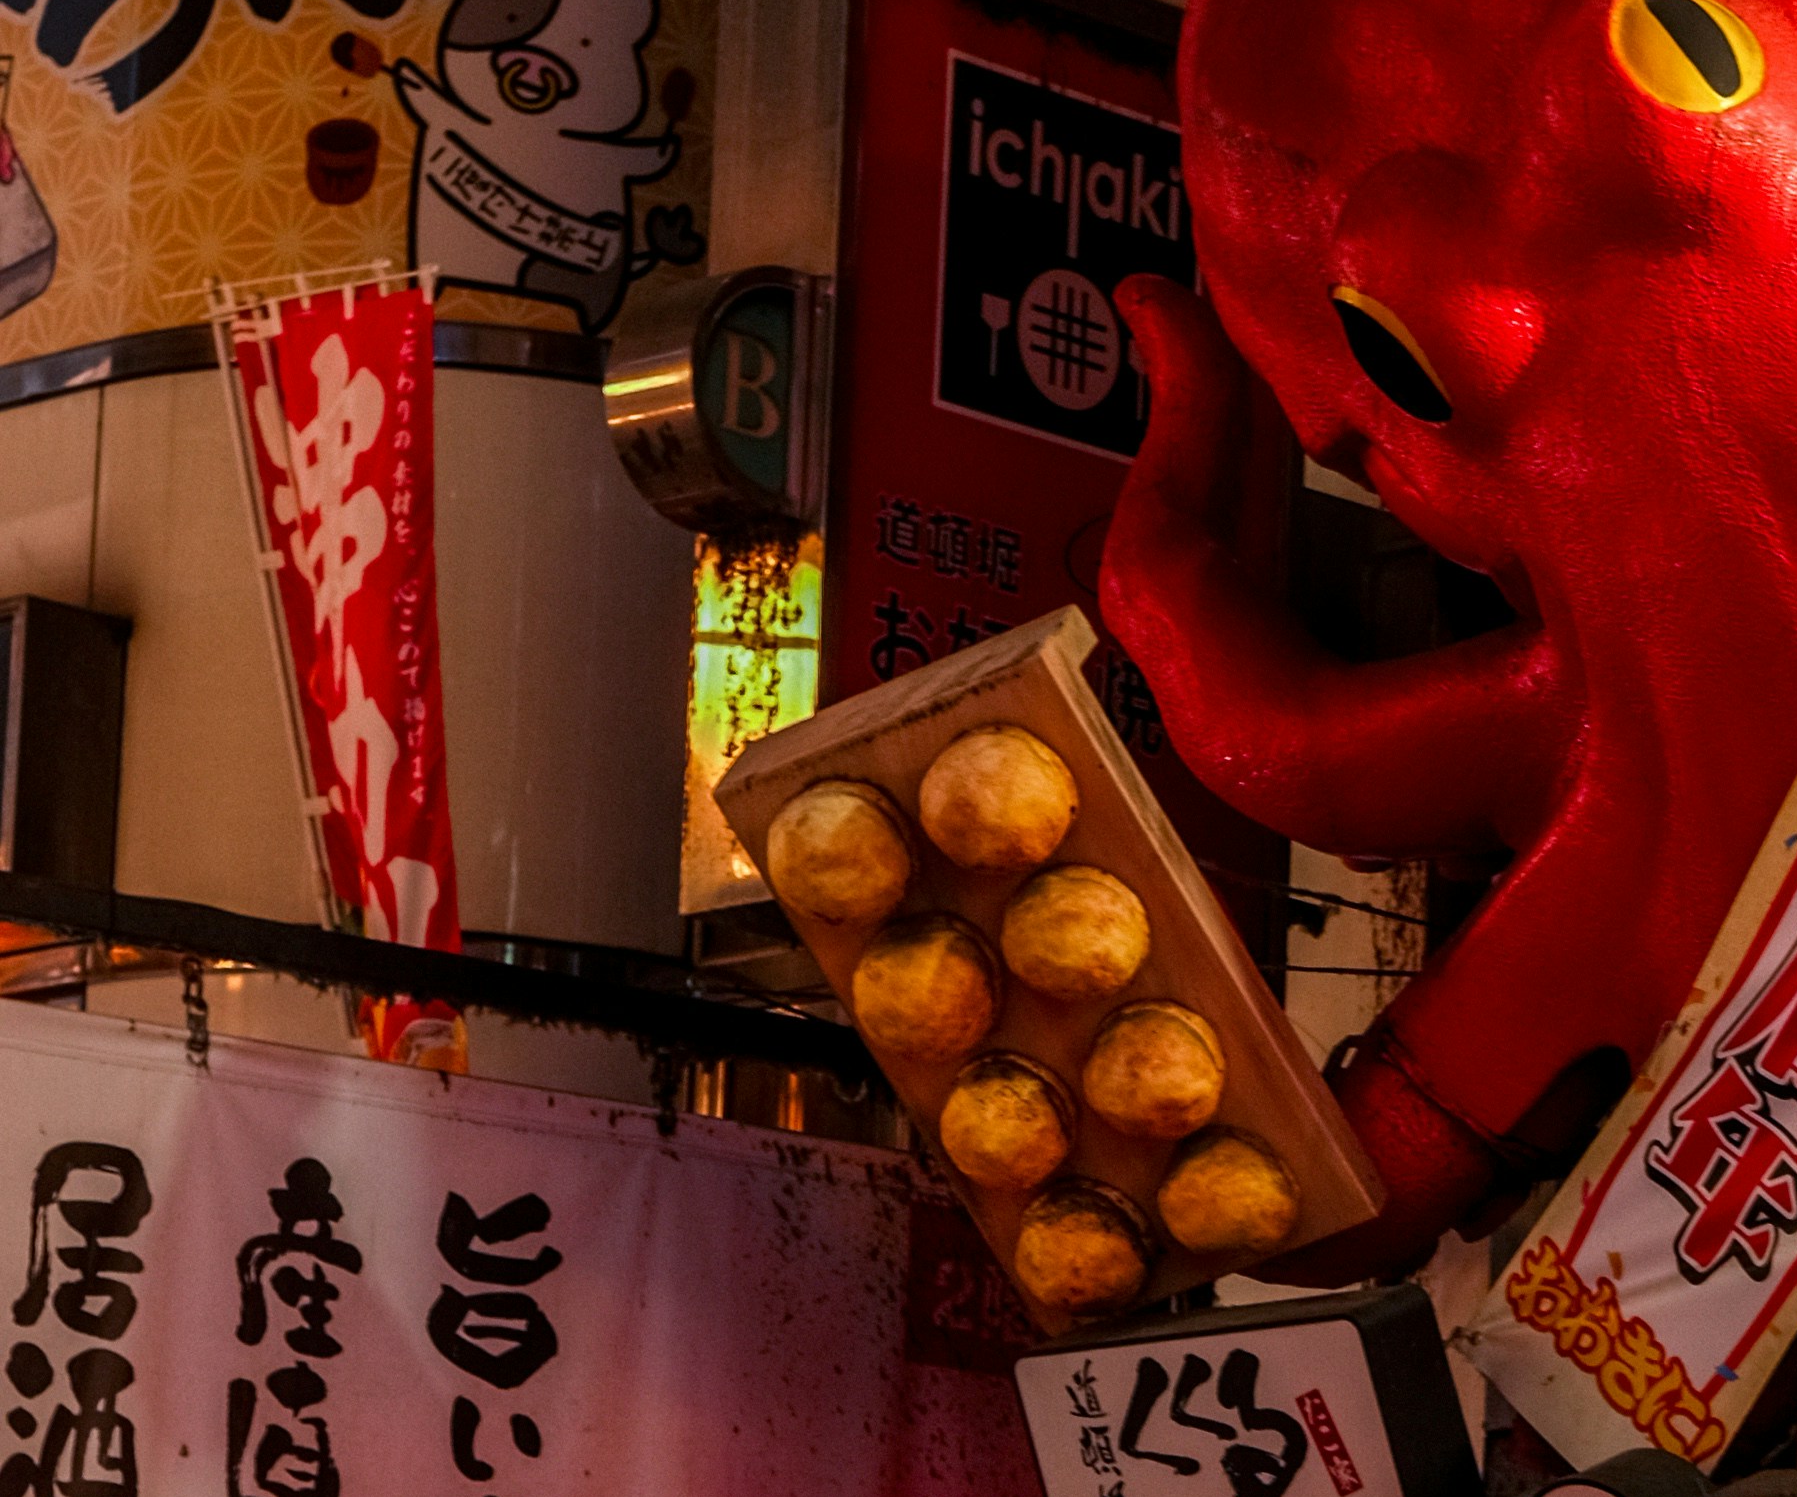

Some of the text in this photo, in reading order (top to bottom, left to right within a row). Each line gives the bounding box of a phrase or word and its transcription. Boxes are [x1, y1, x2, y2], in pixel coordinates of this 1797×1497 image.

[722, 330, 782, 439] B
[874, 492, 1023, 596] 道頓堀
